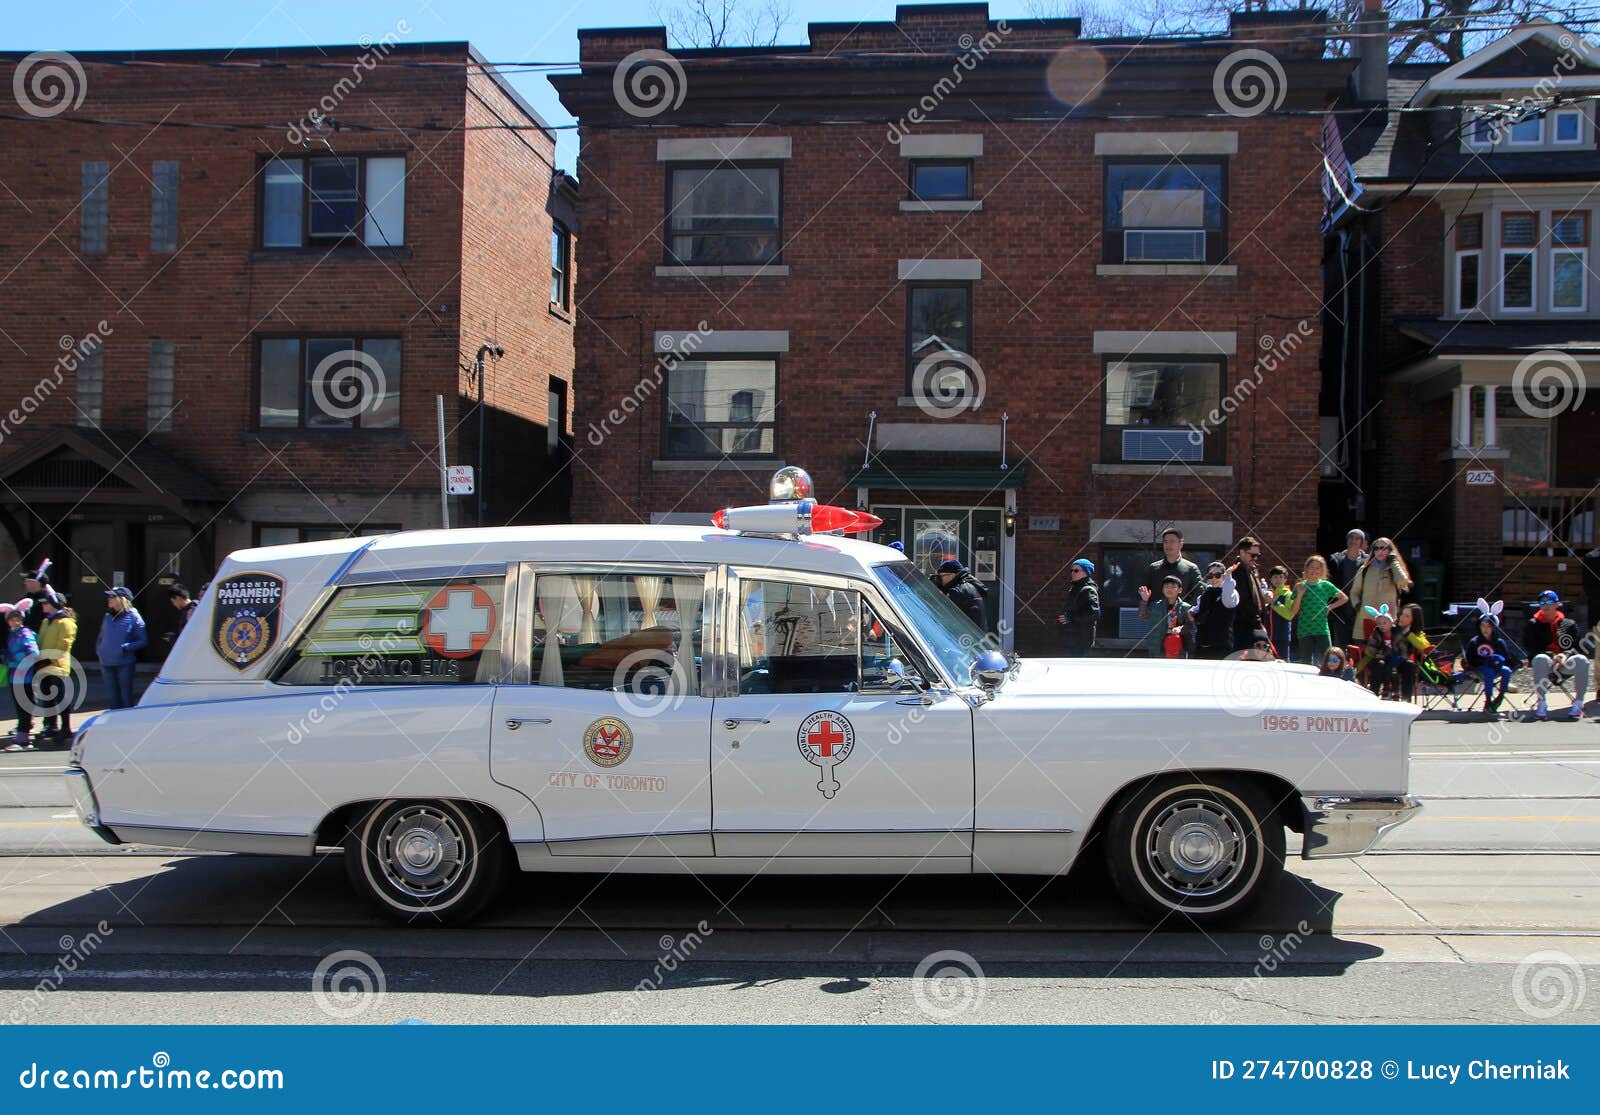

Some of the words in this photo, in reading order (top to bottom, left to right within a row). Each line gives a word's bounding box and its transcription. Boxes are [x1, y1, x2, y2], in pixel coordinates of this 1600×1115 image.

[456, 467, 465, 475] NO
[1469, 471, 1494, 483] 2475
[225, 581, 277, 589] TORONTO
[218, 587, 281, 599] PARAMEDIC
[222, 597, 275, 605] SERVICES
[320, 659, 414, 677] TORONTO
[422, 659, 460, 677] EMS
[807, 713, 833, 725] HEALTH
[1262, 714, 1300, 731] 1966
[1306, 716, 1369, 733] PONTIAC
[800, 727, 819, 753] PUBLIC
[835, 716, 852, 755] AMBULANCE
[548, 772, 577, 787] CITY
[583, 774, 600, 788] OF
[606, 775, 665, 791] TORONTO
